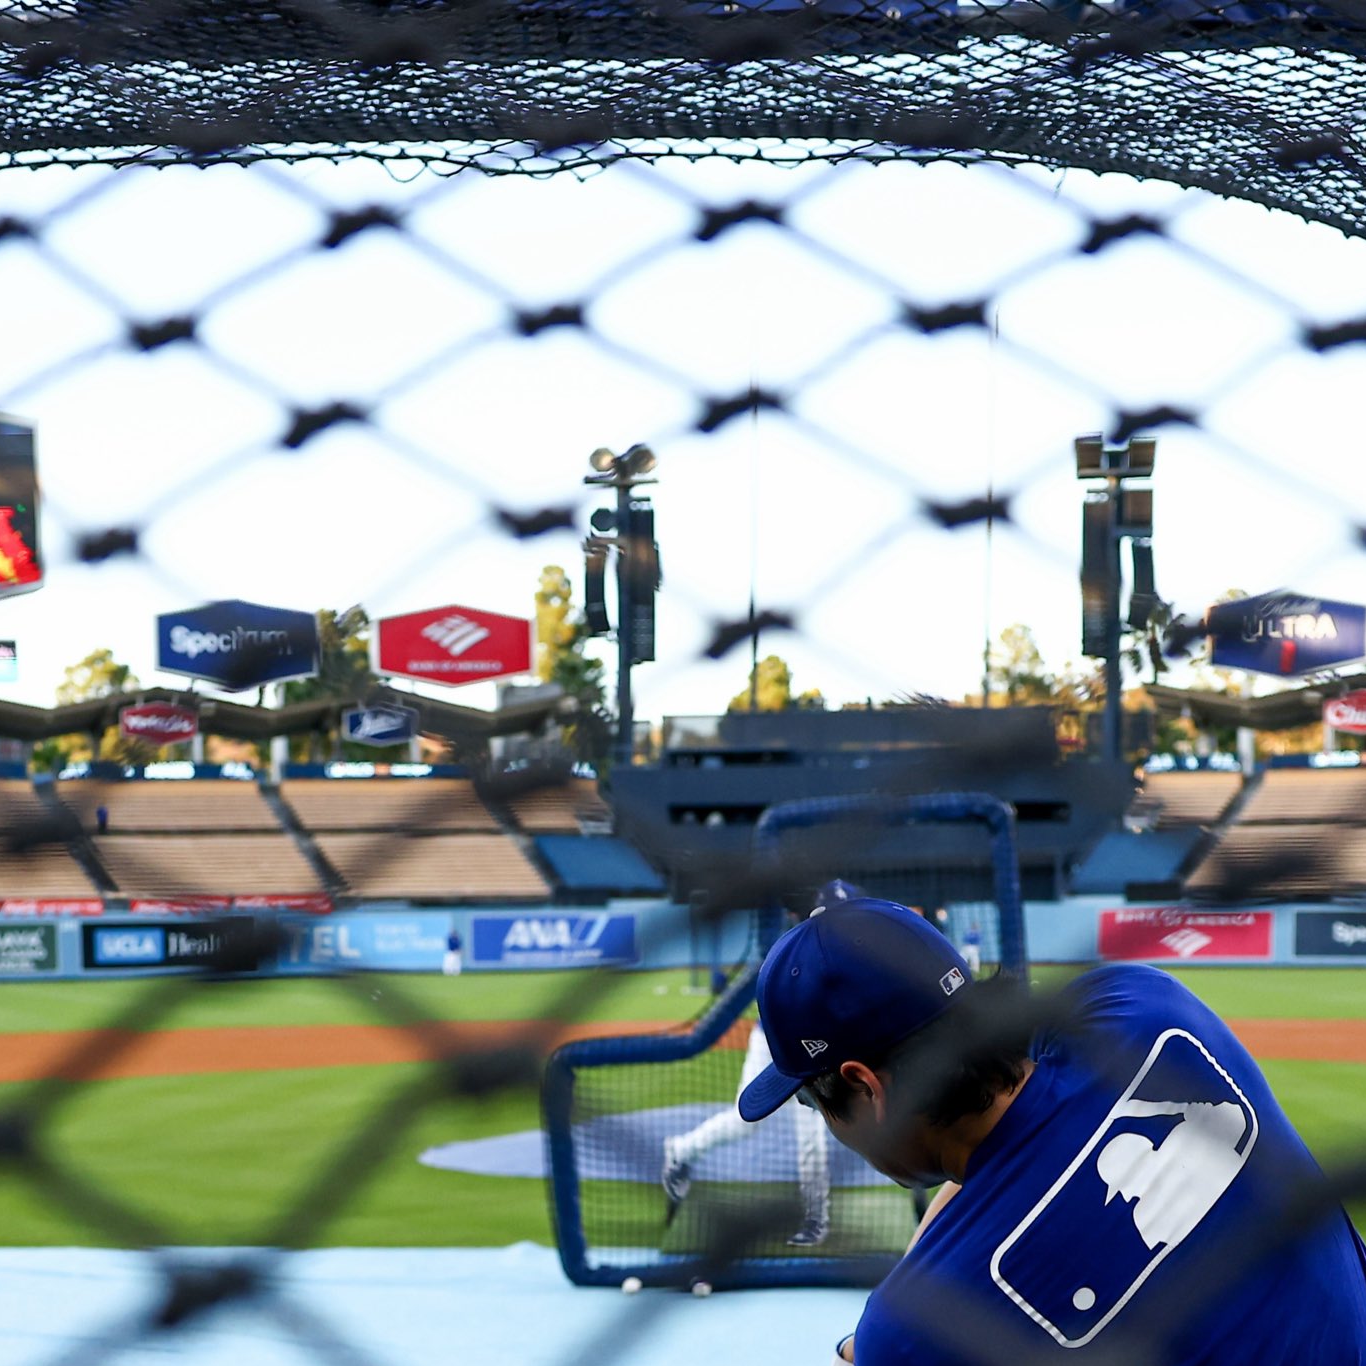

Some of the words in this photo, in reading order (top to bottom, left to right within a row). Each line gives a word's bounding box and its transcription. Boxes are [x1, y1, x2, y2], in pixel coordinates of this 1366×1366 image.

[170, 625, 293, 660] Spectrum
[1242, 612, 1338, 643] ULTRA
[168, 932, 229, 958] Heal
[503, 919, 572, 949] ANA
